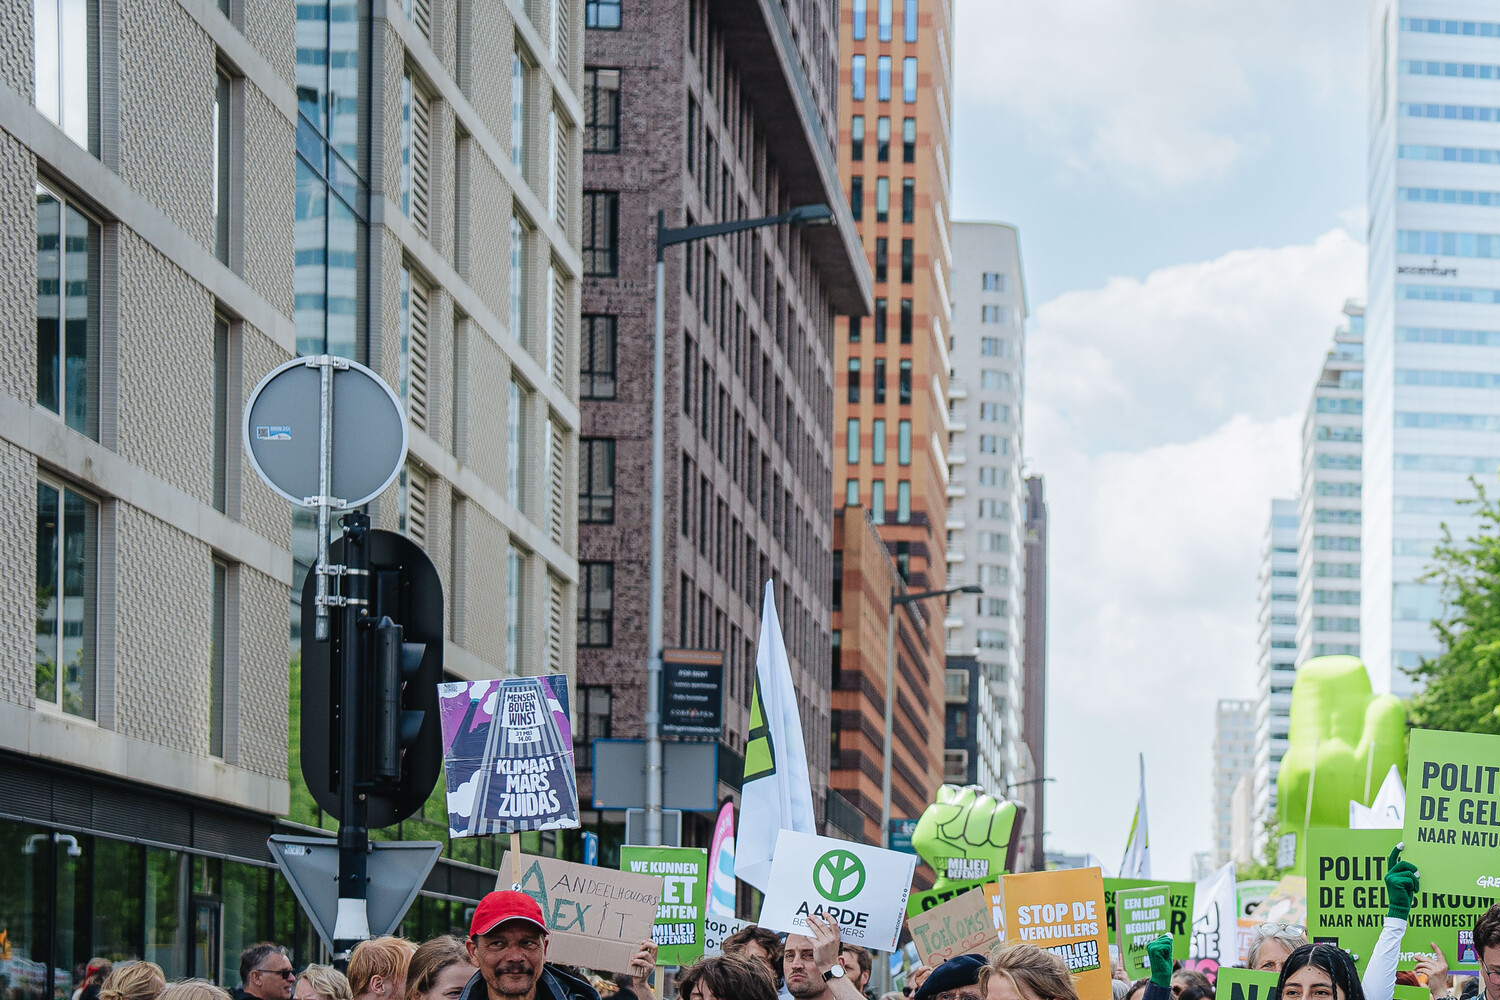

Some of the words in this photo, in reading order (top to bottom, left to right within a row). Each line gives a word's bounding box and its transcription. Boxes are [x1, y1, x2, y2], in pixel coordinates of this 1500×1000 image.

[507, 692, 536, 702] MENSEN
[508, 701, 536, 713] BOVEN
[508, 712, 537, 726] WINST
[496, 756, 556, 775] KLIMAAT
[506, 772, 550, 793] MARS
[498, 790, 561, 818] ZUIDAS
[1419, 795, 1450, 823] DE
[1417, 827, 1457, 845] NAAR
[630, 860, 648, 873] WE
[650, 862, 699, 874] KUNNEN
[948, 857, 989, 871] MILIEU
[1319, 856, 1386, 881] POLIT
[660, 876, 698, 904] ET
[1319, 886, 1345, 909] DE
[1124, 897, 1142, 910] EEN
[1142, 894, 1166, 907] BETER
[795, 901, 869, 928] AARDE
[1017, 902, 1068, 925] STOP
[1072, 900, 1098, 922] DE
[1131, 908, 1160, 921] MILIEU
[1319, 914, 1353, 928] NAAR
[652, 922, 695, 936] MILIEU
[704, 918, 728, 936] top
[1019, 922, 1099, 941] VERVUILERS
[1125, 920, 1155, 934] BEGINT
